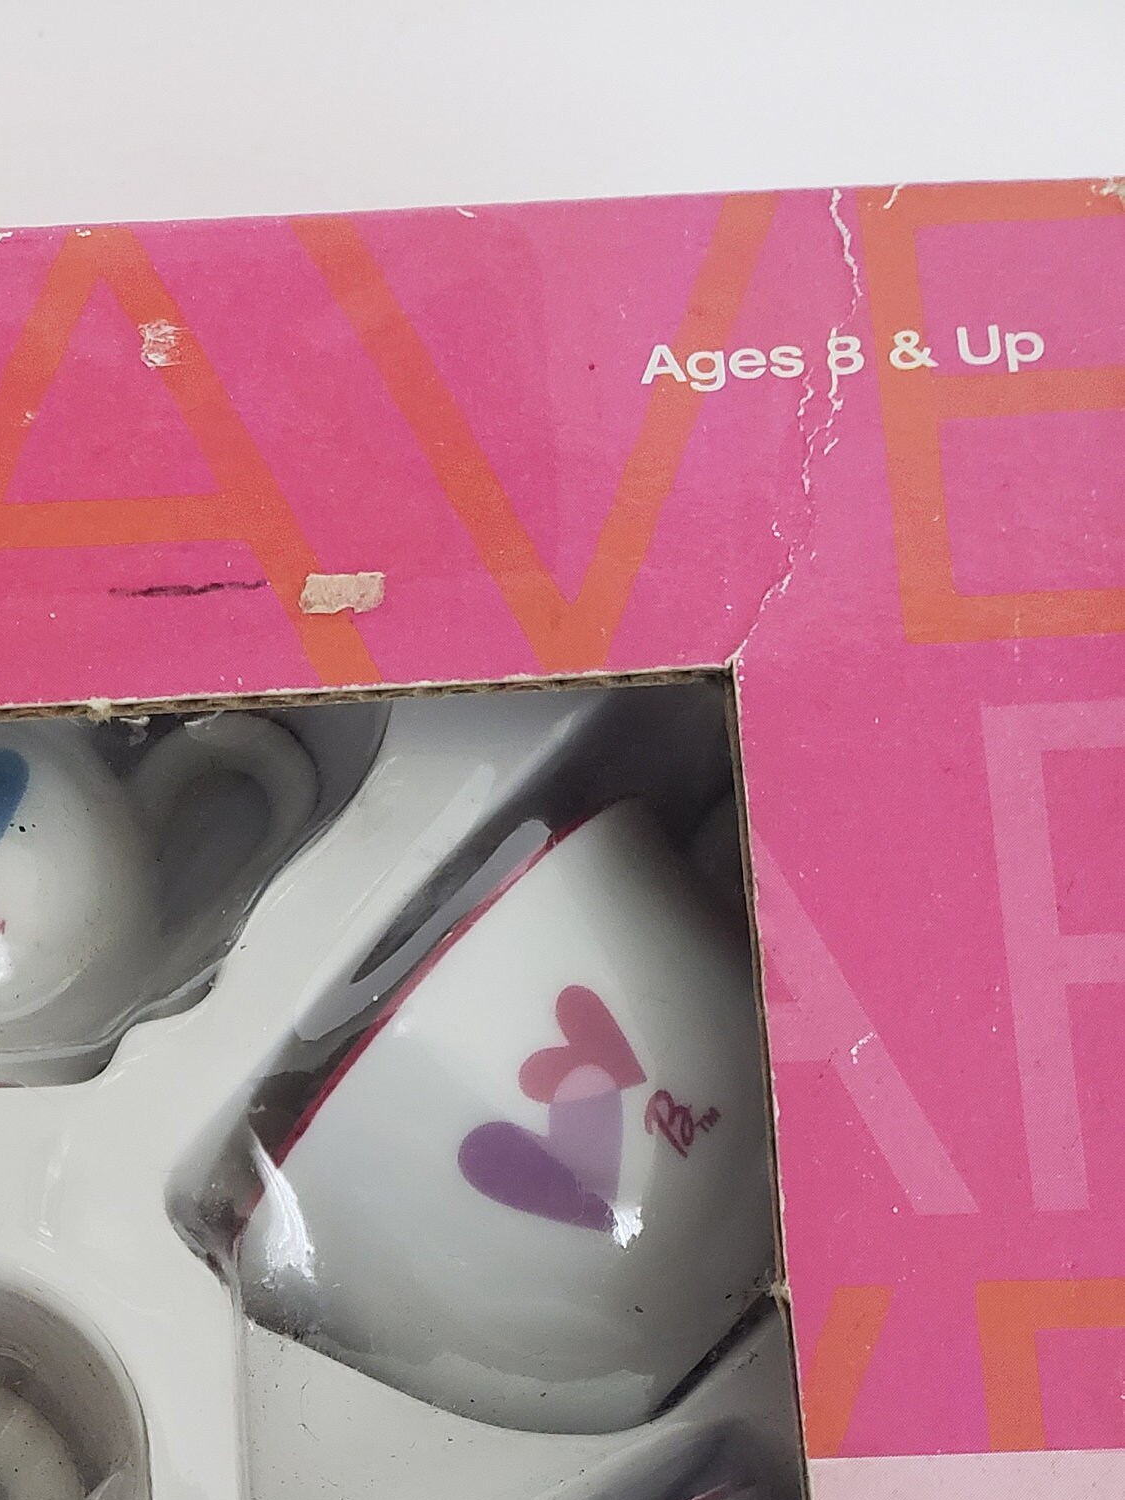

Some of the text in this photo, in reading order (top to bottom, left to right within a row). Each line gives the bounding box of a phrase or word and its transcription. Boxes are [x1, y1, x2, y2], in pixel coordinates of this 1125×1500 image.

[641, 324, 1045, 392] Ages 8 & Up
